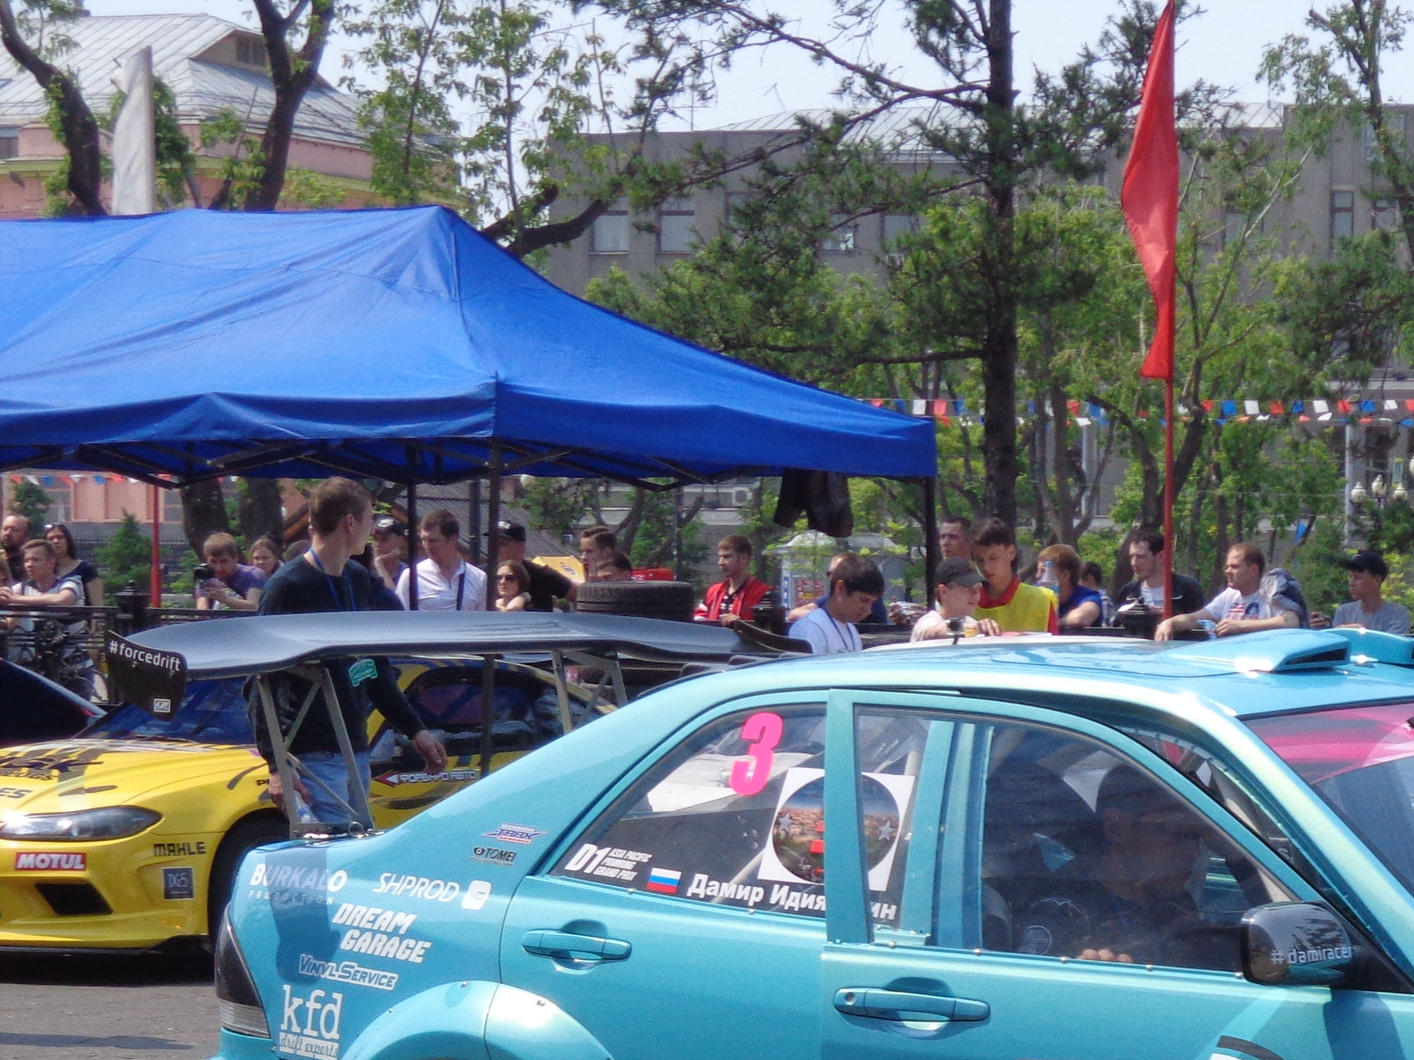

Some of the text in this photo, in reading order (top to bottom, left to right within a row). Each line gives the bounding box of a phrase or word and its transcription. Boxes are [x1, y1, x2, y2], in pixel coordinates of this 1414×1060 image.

[109, 640, 181, 672] #forcedrift
[729, 713, 784, 796] 3
[16, 853, 85, 870] MOTUL
[153, 842, 206, 857] MAHLE
[485, 847, 517, 862] TOMEI
[564, 843, 612, 874] D1
[249, 863, 348, 892] BURKALO
[372, 872, 460, 902] SHPROD
[686, 873, 898, 921] Дамир Идияин
[332, 902, 418, 935] DREAM
[340, 929, 433, 964] GARAGE
[281, 984, 343, 1040] kfd
